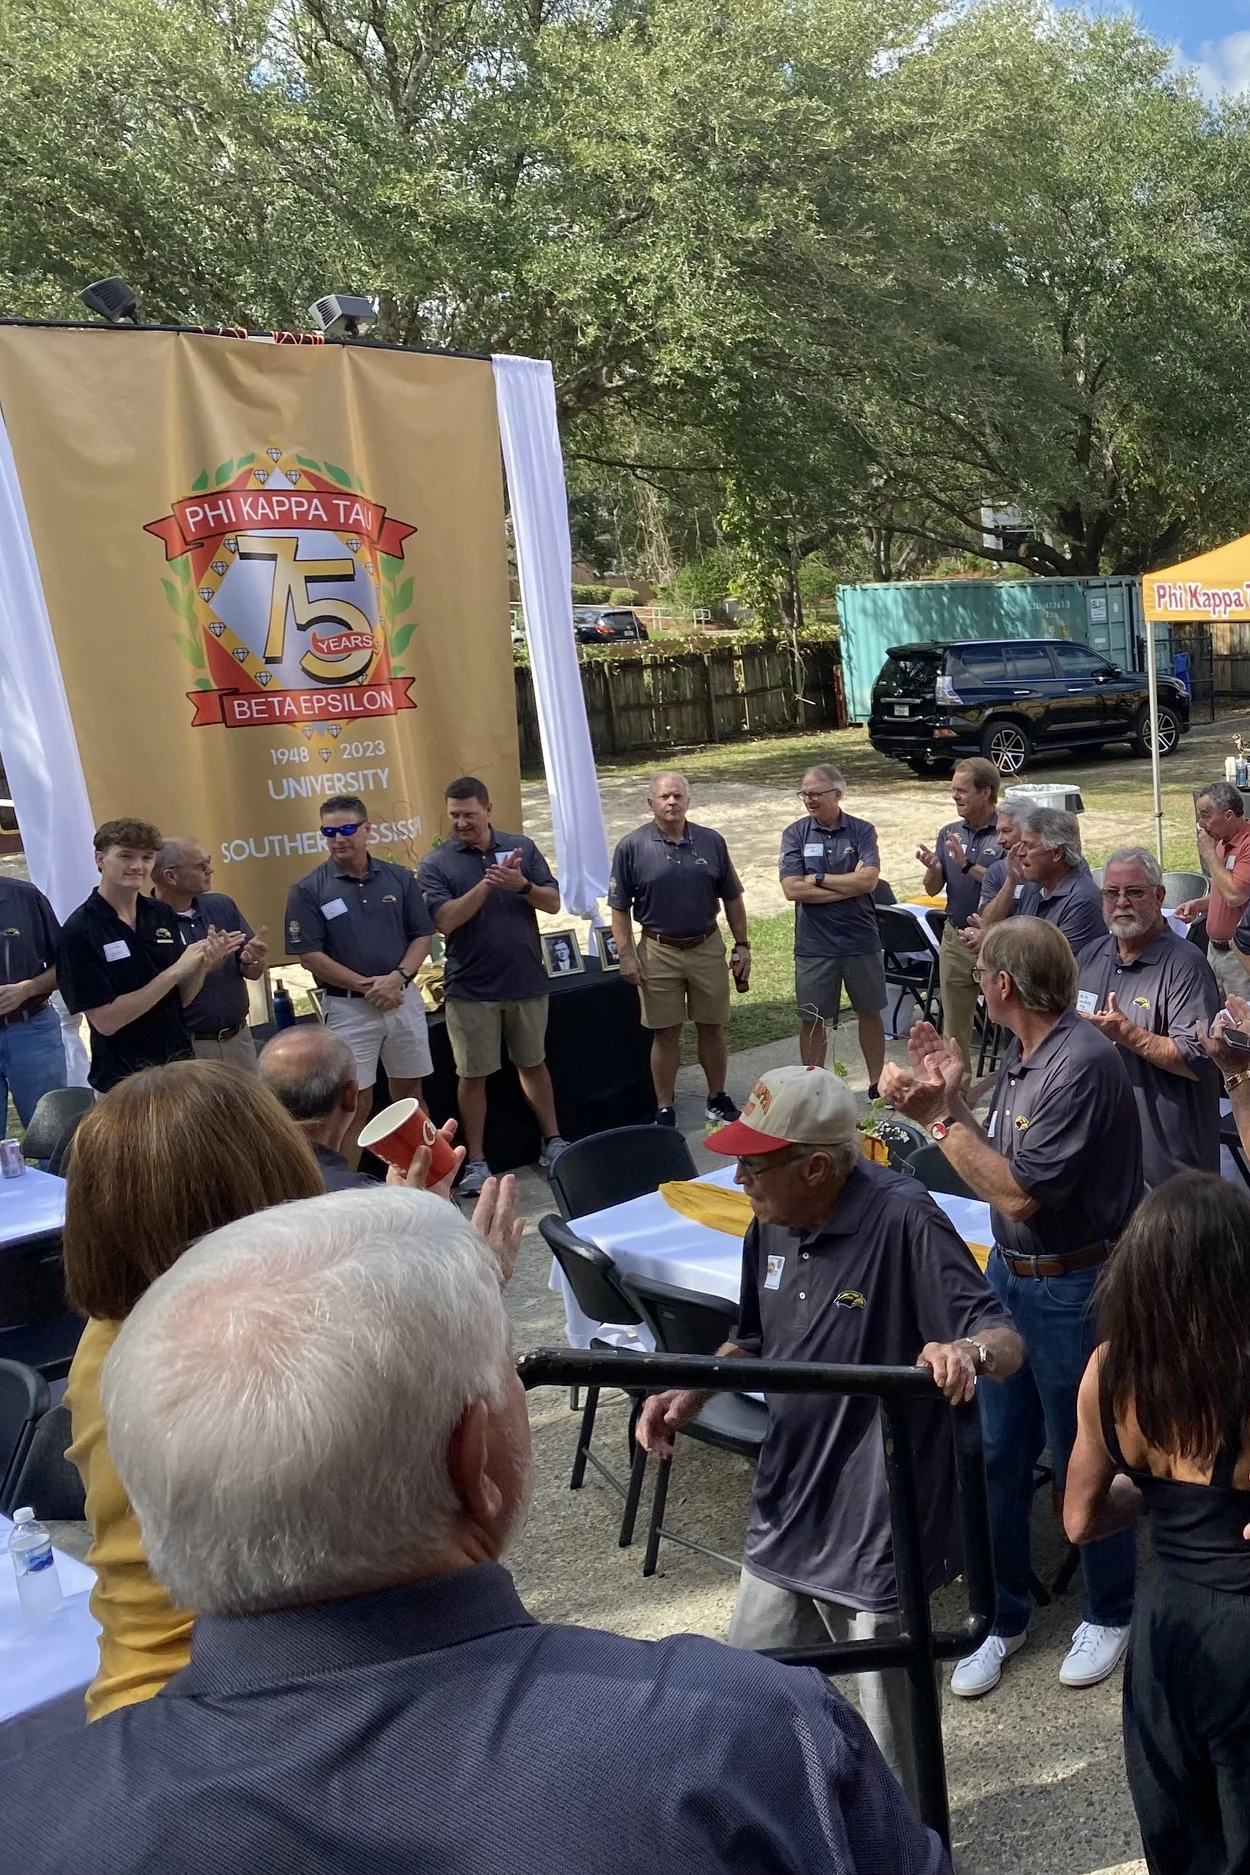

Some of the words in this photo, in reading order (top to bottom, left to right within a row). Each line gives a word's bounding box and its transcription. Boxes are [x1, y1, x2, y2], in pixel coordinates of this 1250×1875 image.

[184, 498, 237, 532] PHI
[240, 496, 328, 523] KAPPA
[332, 499, 373, 531] TAU
[236, 535, 374, 685] 75
[1156, 584, 1183, 609] Phi
[1188, 584, 1244, 615] Kappa
[318, 634, 373, 654] YEARS
[233, 696, 299, 720] BETA
[300, 689, 394, 715] EPSILON
[270, 746, 310, 765] 1948
[340, 739, 386, 759] 2023
[267, 767, 389, 800] UNIVERSITY
[220, 830, 330, 863] SOUTHER
